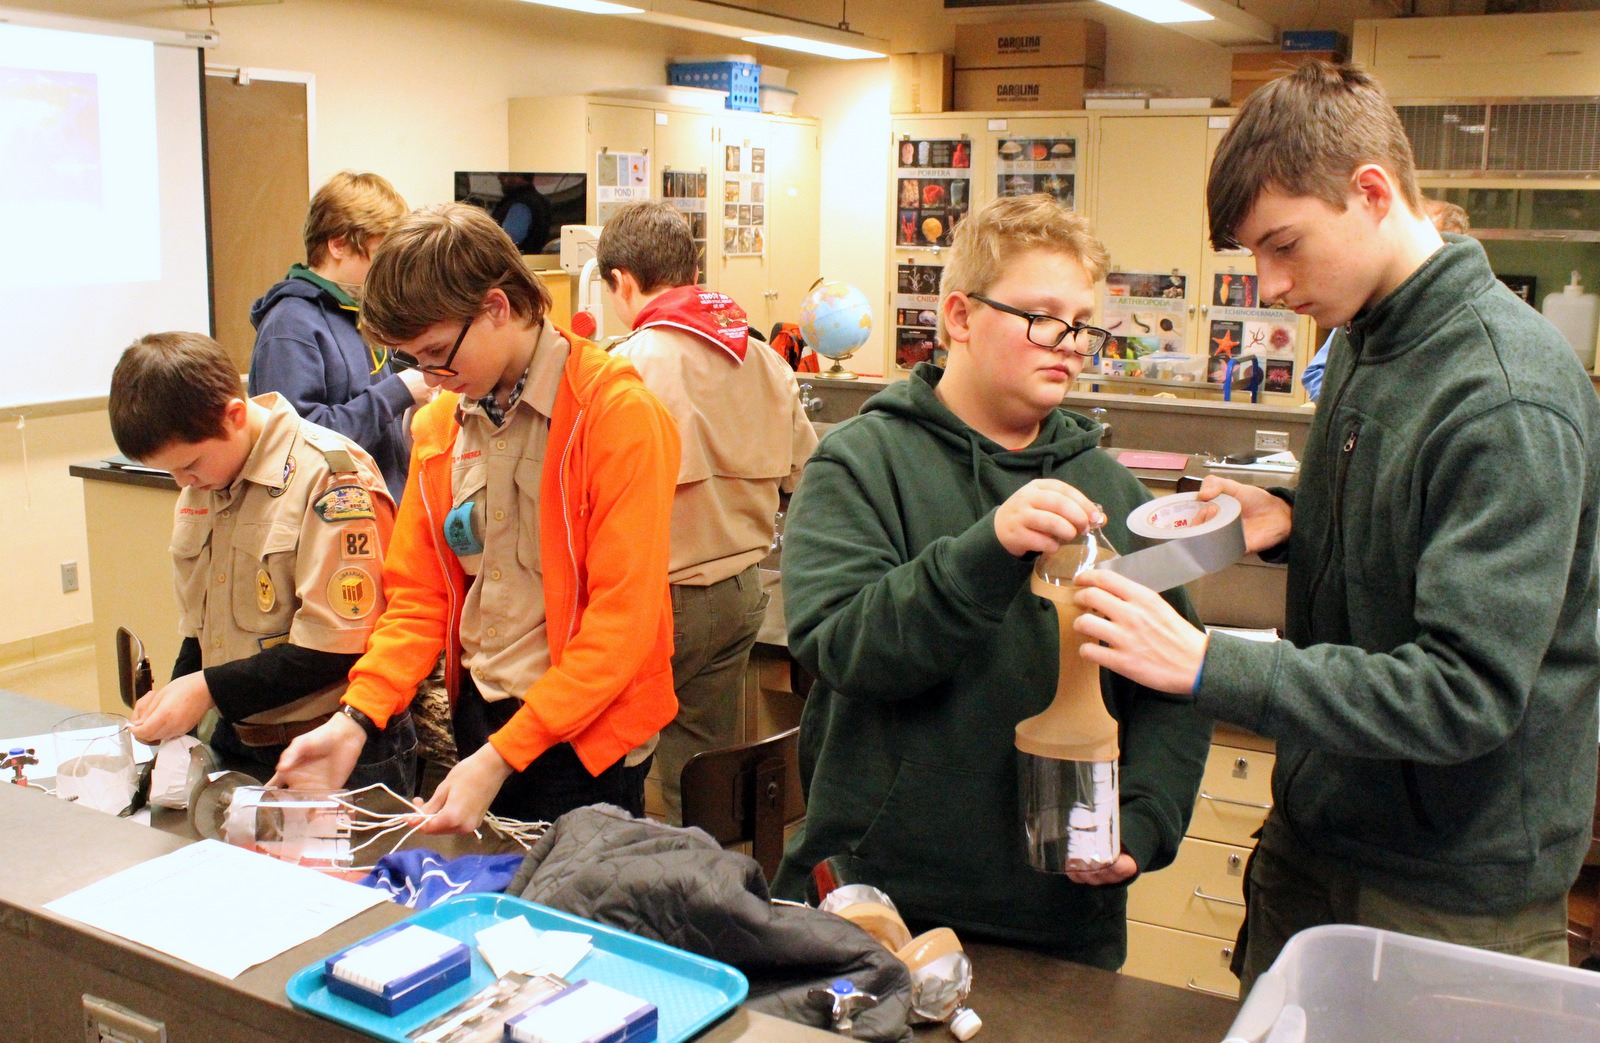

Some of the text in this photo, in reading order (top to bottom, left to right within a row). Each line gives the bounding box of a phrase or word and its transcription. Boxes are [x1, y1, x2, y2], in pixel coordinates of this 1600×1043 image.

[998, 36, 1041, 49] CAROLINA
[997, 84, 1040, 96] CAROLINA
[614, 187, 632, 197] POND
[916, 295, 939, 303] CNIDA
[1117, 297, 1171, 307] ARTHROPODA
[1224, 309, 1284, 318] ECHINODERMATA
[1173, 519, 1188, 528] 3M
[346, 533, 370, 555] 82
[338, 571, 364, 580] LIBRARIAN
